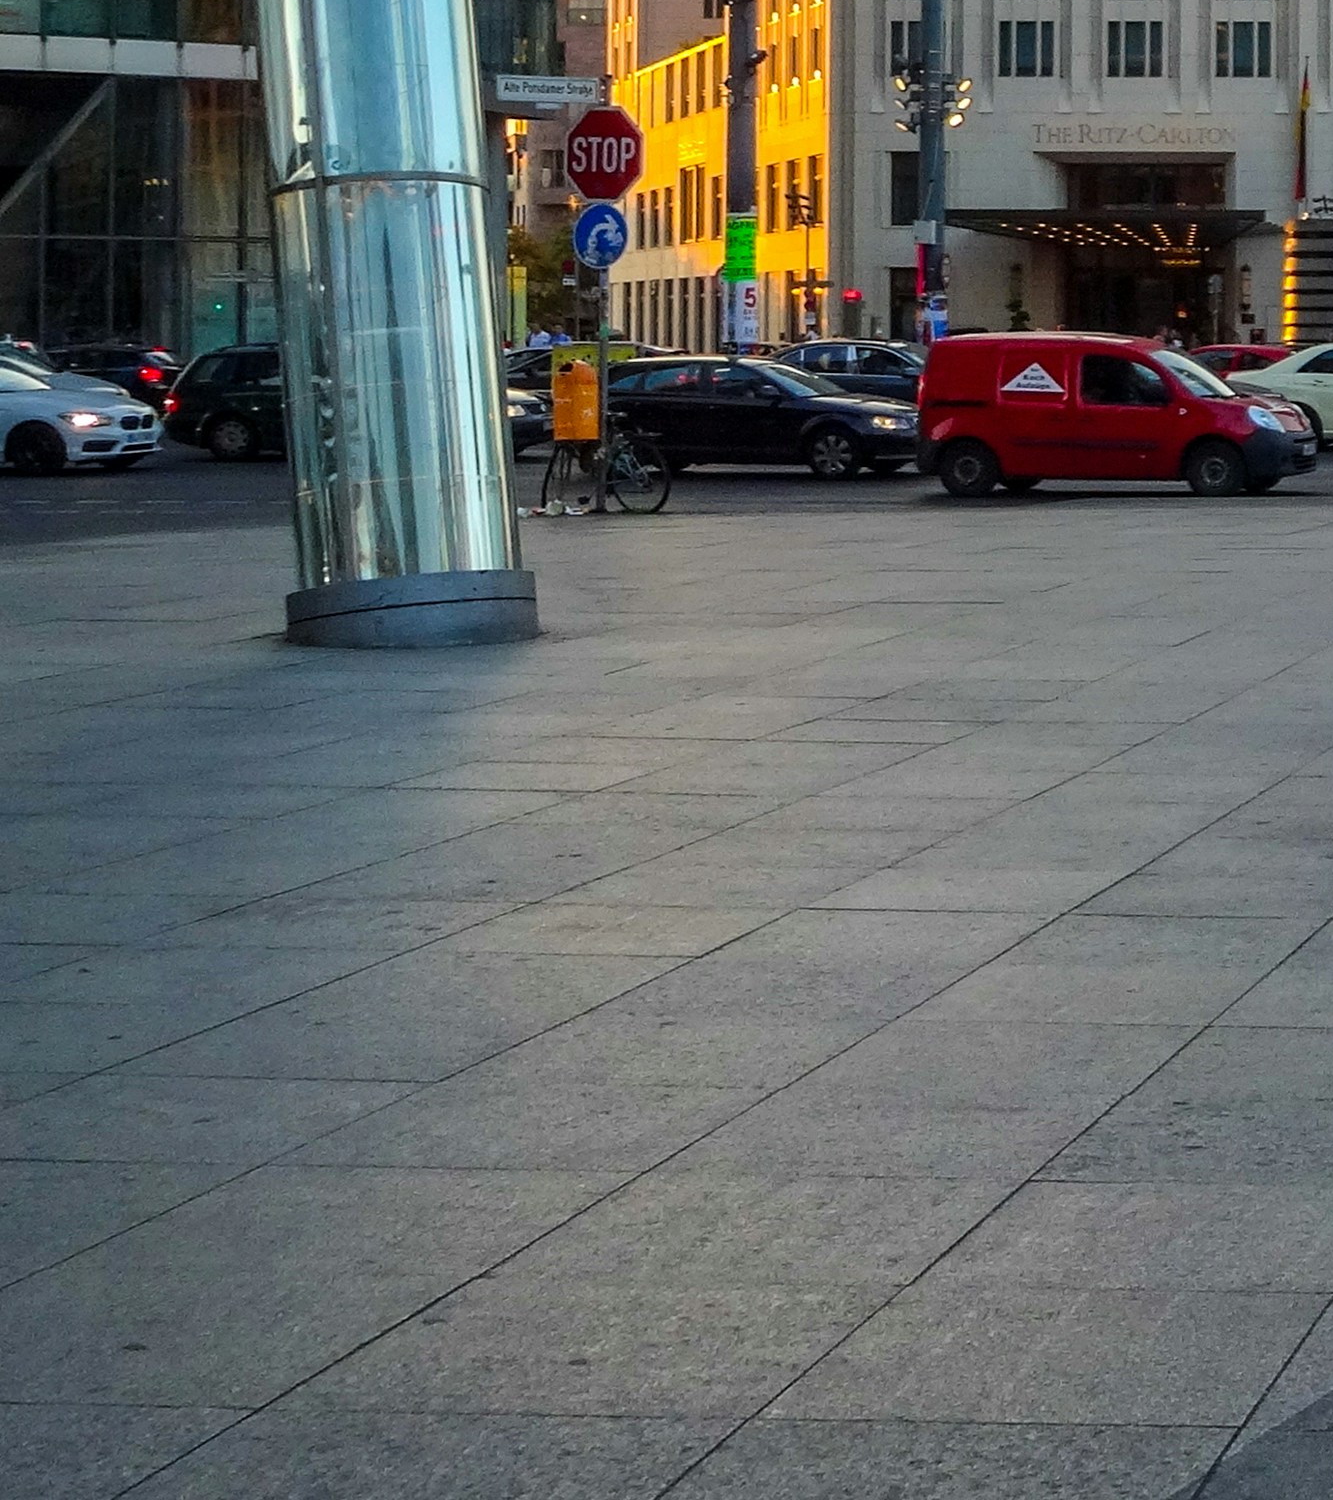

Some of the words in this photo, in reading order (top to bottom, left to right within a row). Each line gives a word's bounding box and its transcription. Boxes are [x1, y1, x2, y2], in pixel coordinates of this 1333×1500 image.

[503, 82, 520, 93] Alte
[522, 82, 565, 94] Potsdamer
[572, 136, 636, 173] STOP
